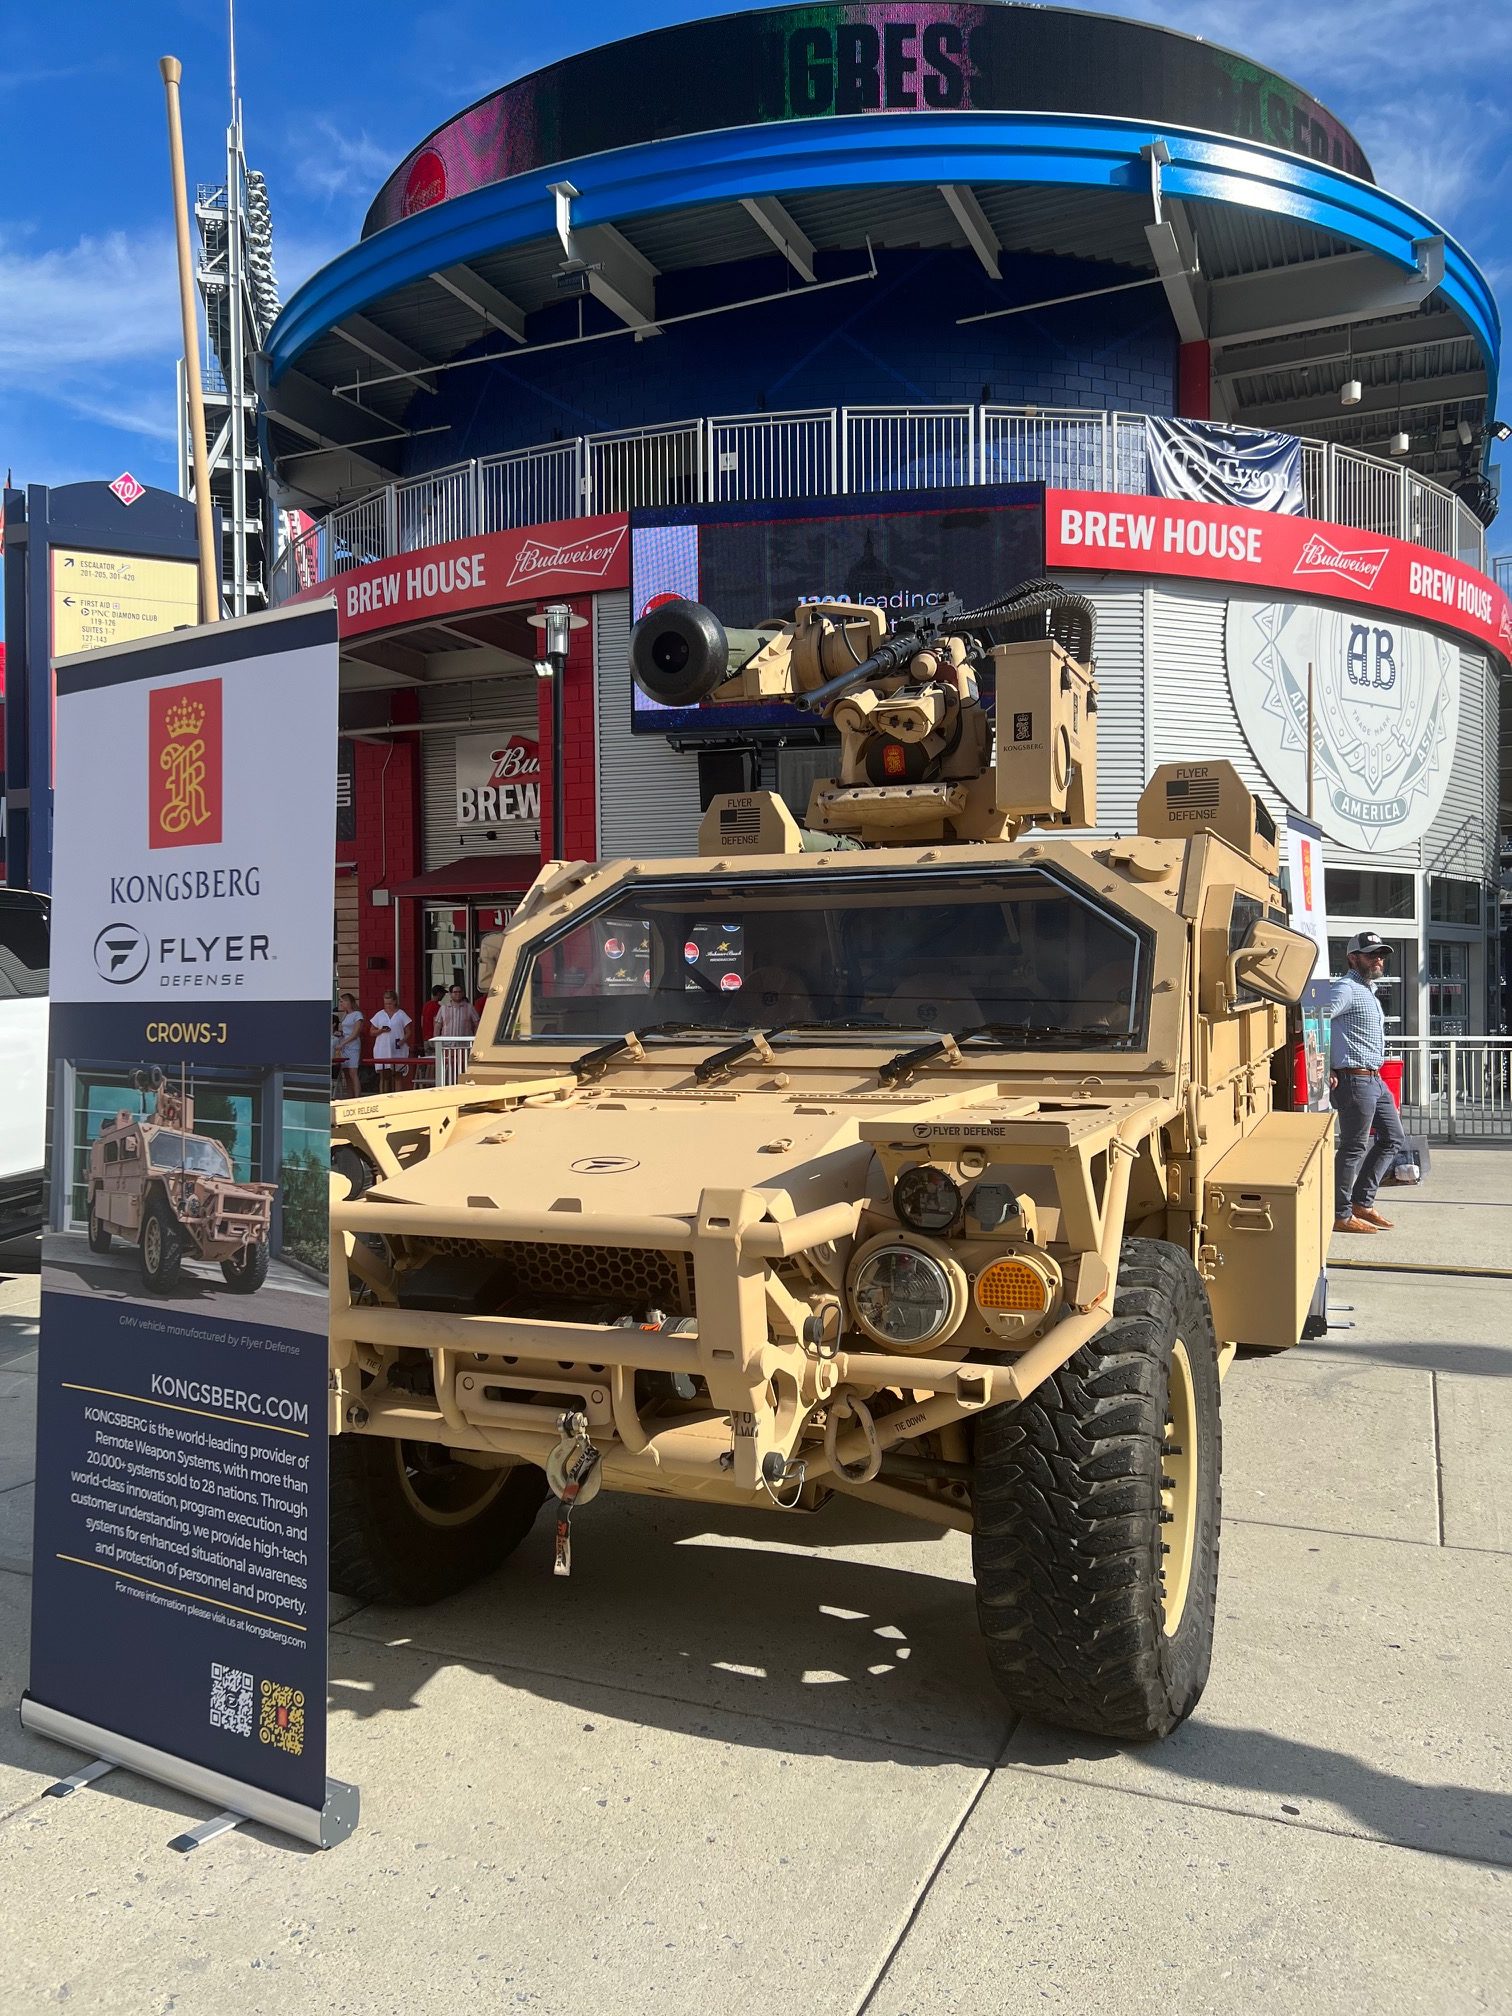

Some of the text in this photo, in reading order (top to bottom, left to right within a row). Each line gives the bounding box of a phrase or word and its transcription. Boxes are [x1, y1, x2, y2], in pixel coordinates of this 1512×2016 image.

[1216, 457, 1289, 492] Tyson
[1060, 508, 1262, 564] BREW HOUSE
[80, 560, 115, 571] ESCALATOR
[518, 544, 616, 573] Budweiser
[1303, 537, 1380, 576] Budweiser
[347, 553, 487, 618] BREW HOUSE
[1409, 562, 1493, 625] BREW HOUSE
[80, 599, 111, 609] FIRST AID
[91, 609, 158, 622] PNC DIAMOND CLUB
[81, 626, 104, 635] SUITES
[1353, 710, 1391, 736] TRADE MARK
[1003, 743, 1044, 752] KONGSBERG
[1416, 718, 1436, 764] ASIA
[490, 746, 540, 778] Bu
[1176, 767, 1209, 779] FLYER
[457, 783, 540, 823] BREW
[727, 798, 752, 808] FLYER
[1168, 809, 1217, 822] DEFENSE
[1341, 796, 1400, 820] AMERICA
[721, 835, 759, 846] DEFENSE
[110, 866, 260, 904] KONGSBERG
[160, 934, 270, 964] FLYER
[159, 973, 244, 987] DEFENSE
[146, 1021, 228, 1045] CROWS-J
[343, 1105, 379, 1118] LOCK RELEASE
[933, 1126, 1006, 1137] FLYER DEFENSE
[119, 1315, 301, 1356] GMV vehicle manufactured by Flyer Defense
[151, 1373, 309, 1425] KONGSBERG.COM
[84, 1406, 310, 1470] KONGSBERG is the world-leading provider of
[894, 1412, 927, 1433] TIE DOWN
[95, 1430, 308, 1494] Remote Weapon Systems, with more than
[86, 1450, 308, 1519] 20,000+ systems sold to 28 nations. Through
[70, 1470, 308, 1542] world-class innovation, program execution, and
[70, 1492, 308, 1566] customer understanding, we provide high-tech
[85, 1518, 308, 1590] systems for enhanced situational awareness
[95, 1541, 307, 1616] and protection of personnel and property.
[115, 1581, 307, 1650] For more information please visit us at kongsberg.com
